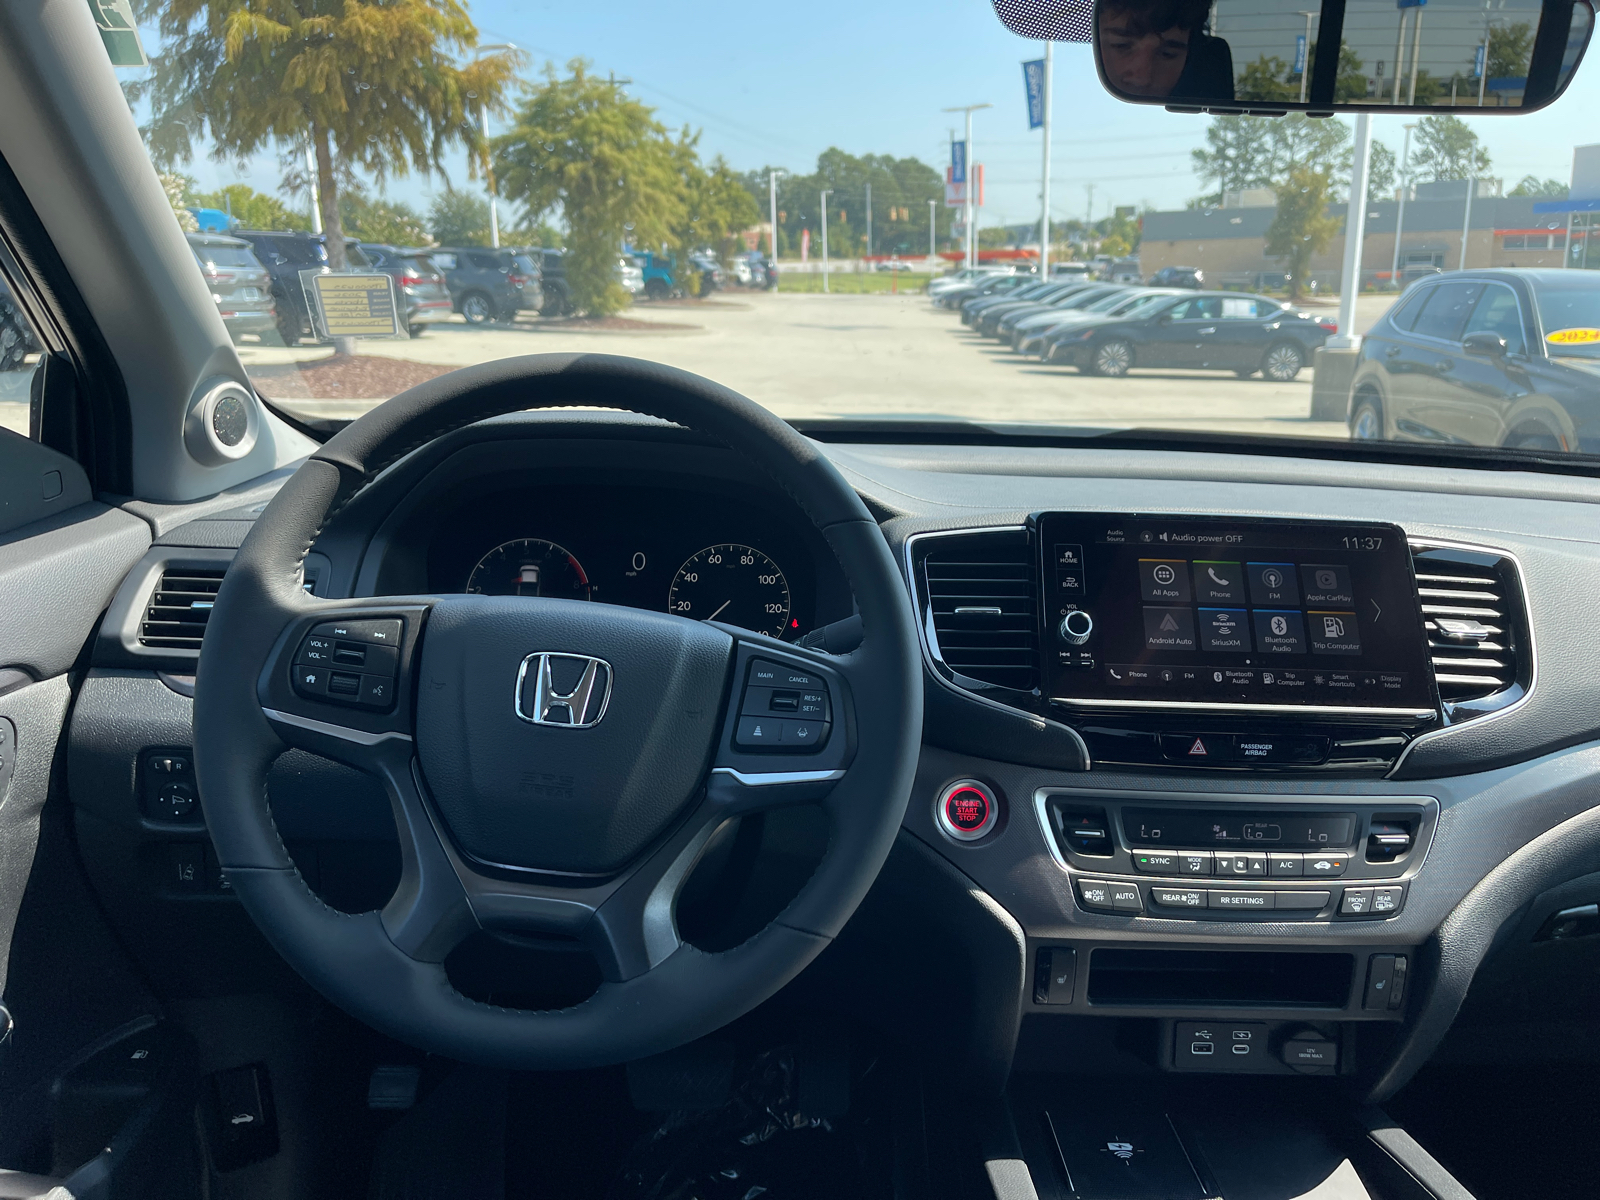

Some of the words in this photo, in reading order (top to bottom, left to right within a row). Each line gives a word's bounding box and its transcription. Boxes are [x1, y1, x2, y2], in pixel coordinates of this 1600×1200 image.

[1557, 330, 1600, 342] 2024
[1171, 533, 1196, 541] Audio
[1198, 535, 1223, 543] power
[1225, 535, 1243, 543] OFF
[1343, 536, 1383, 550] 11:37
[632, 551, 646, 571] 0
[708, 554, 722, 564] 60
[740, 555, 754, 565] 80
[684, 573, 698, 582] 40
[758, 575, 776, 584] 100
[475, 586, 482, 594] 2
[1307, 594, 1325, 602] Apple
[1326, 595, 1351, 603] CarPlay
[677, 601, 691, 611] 20
[764, 604, 783, 613] 120
[310, 640, 322, 648] VOL
[1313, 642, 1325, 650] Trip
[1326, 643, 1360, 651] Computer
[788, 676, 809, 684] CANCEL
[1380, 675, 1402, 683] Display
[803, 694, 822, 702] RES/+
[1115, 892, 1135, 900] AUTO
